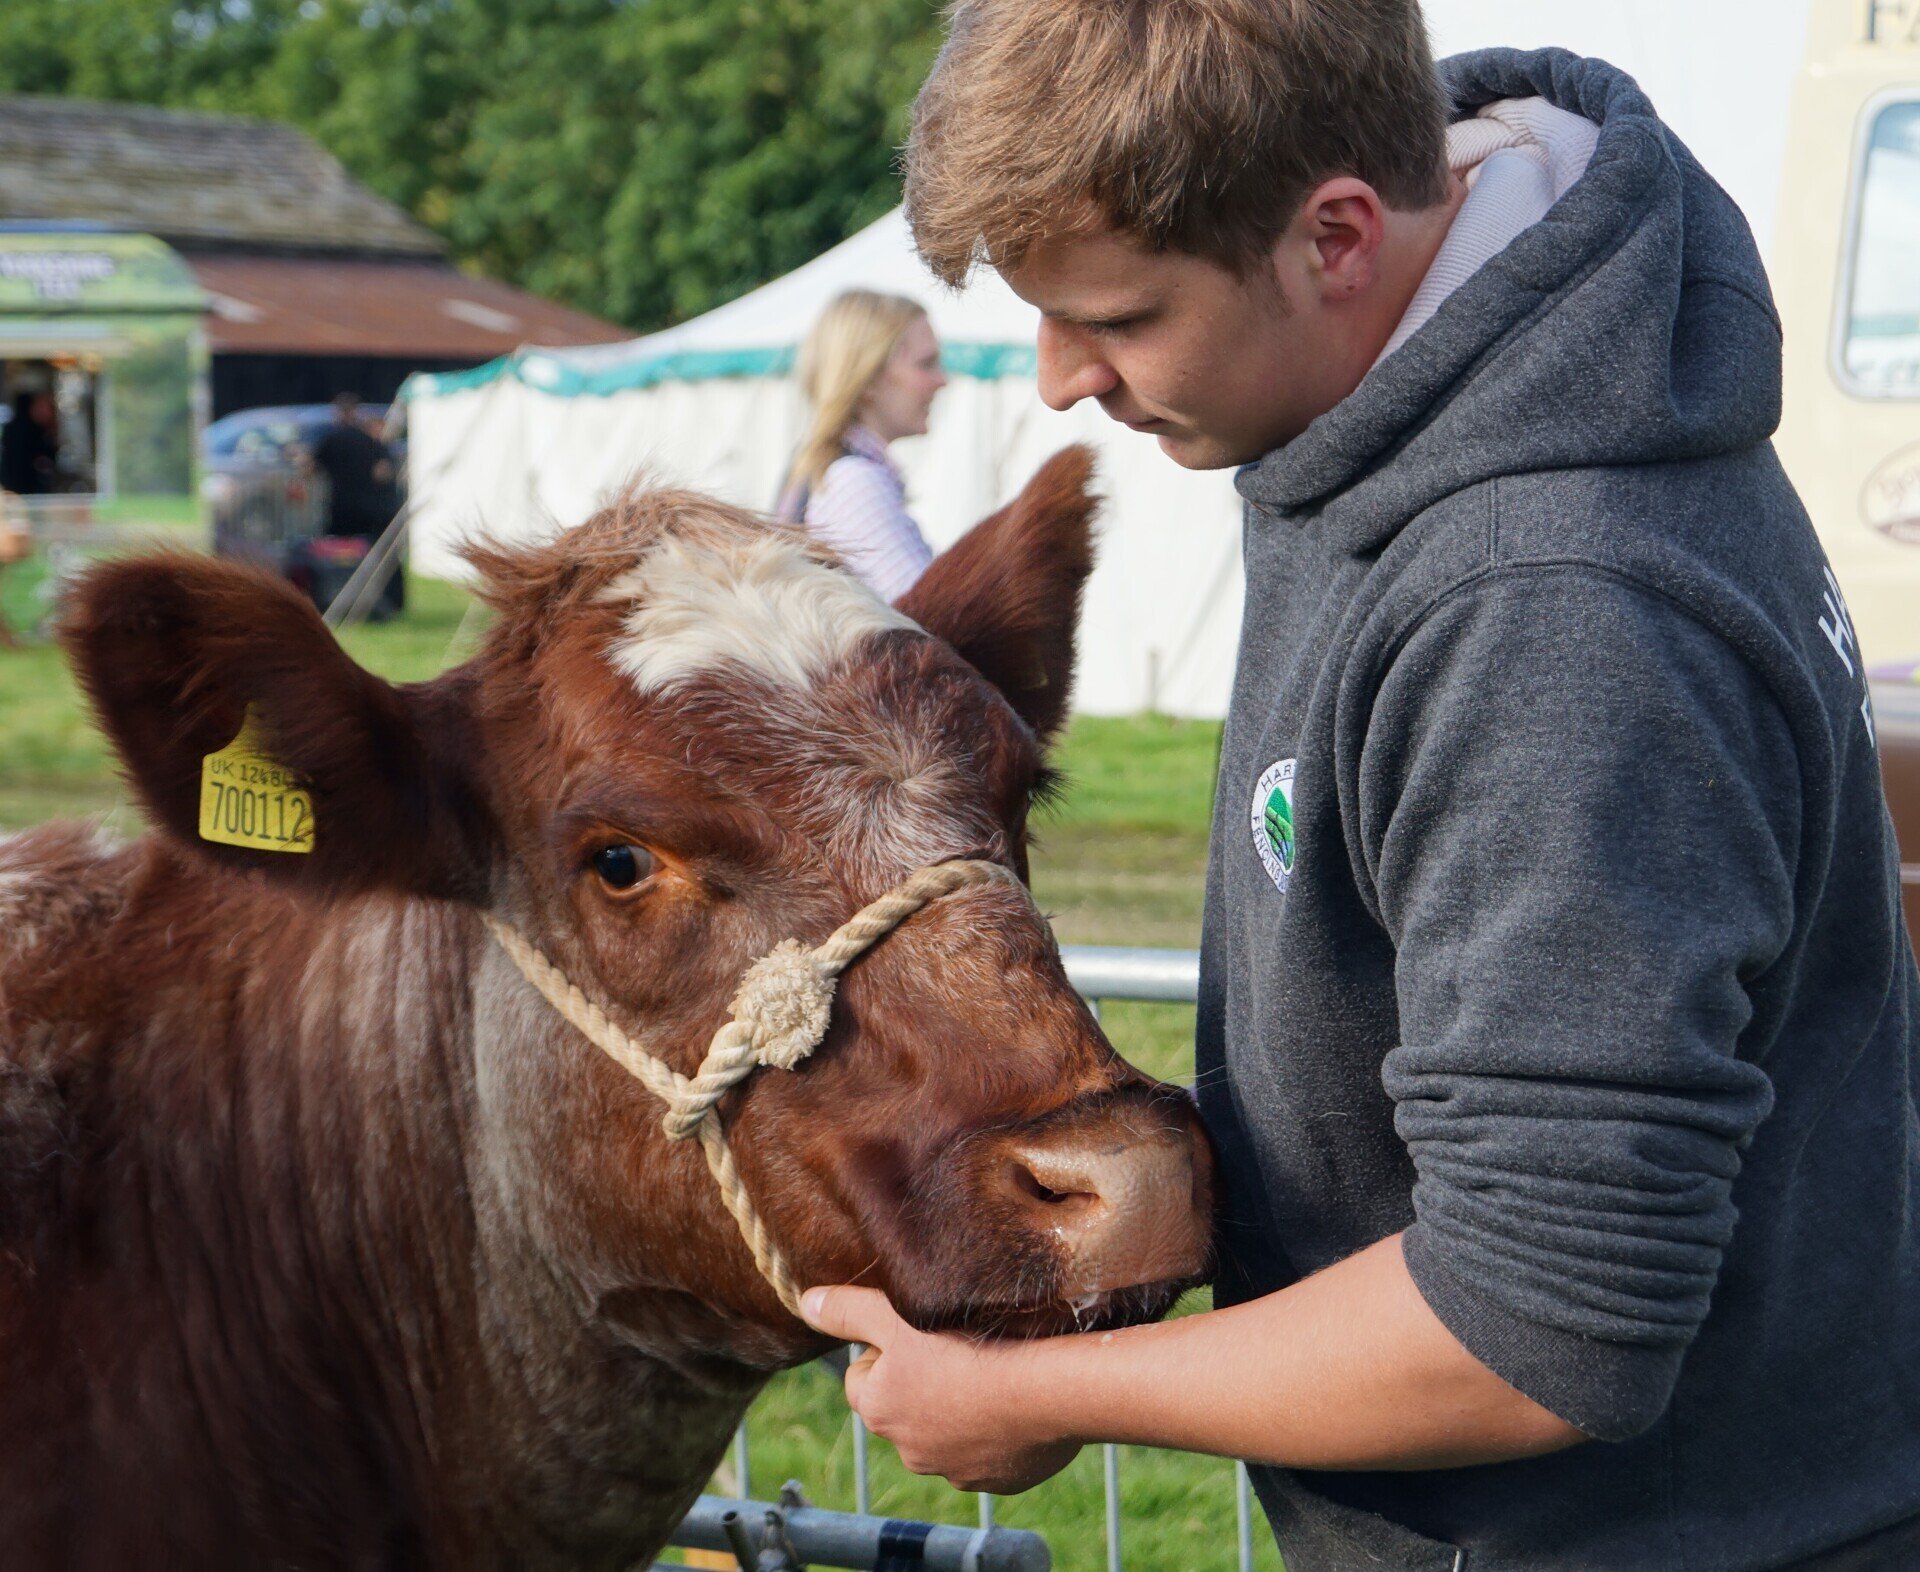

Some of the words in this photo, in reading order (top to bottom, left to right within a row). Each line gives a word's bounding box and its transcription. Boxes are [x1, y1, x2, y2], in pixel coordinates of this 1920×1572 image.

[210, 757, 234, 777] UK
[210, 780, 306, 843] 700112
[1252, 815, 1281, 880] FENCING
